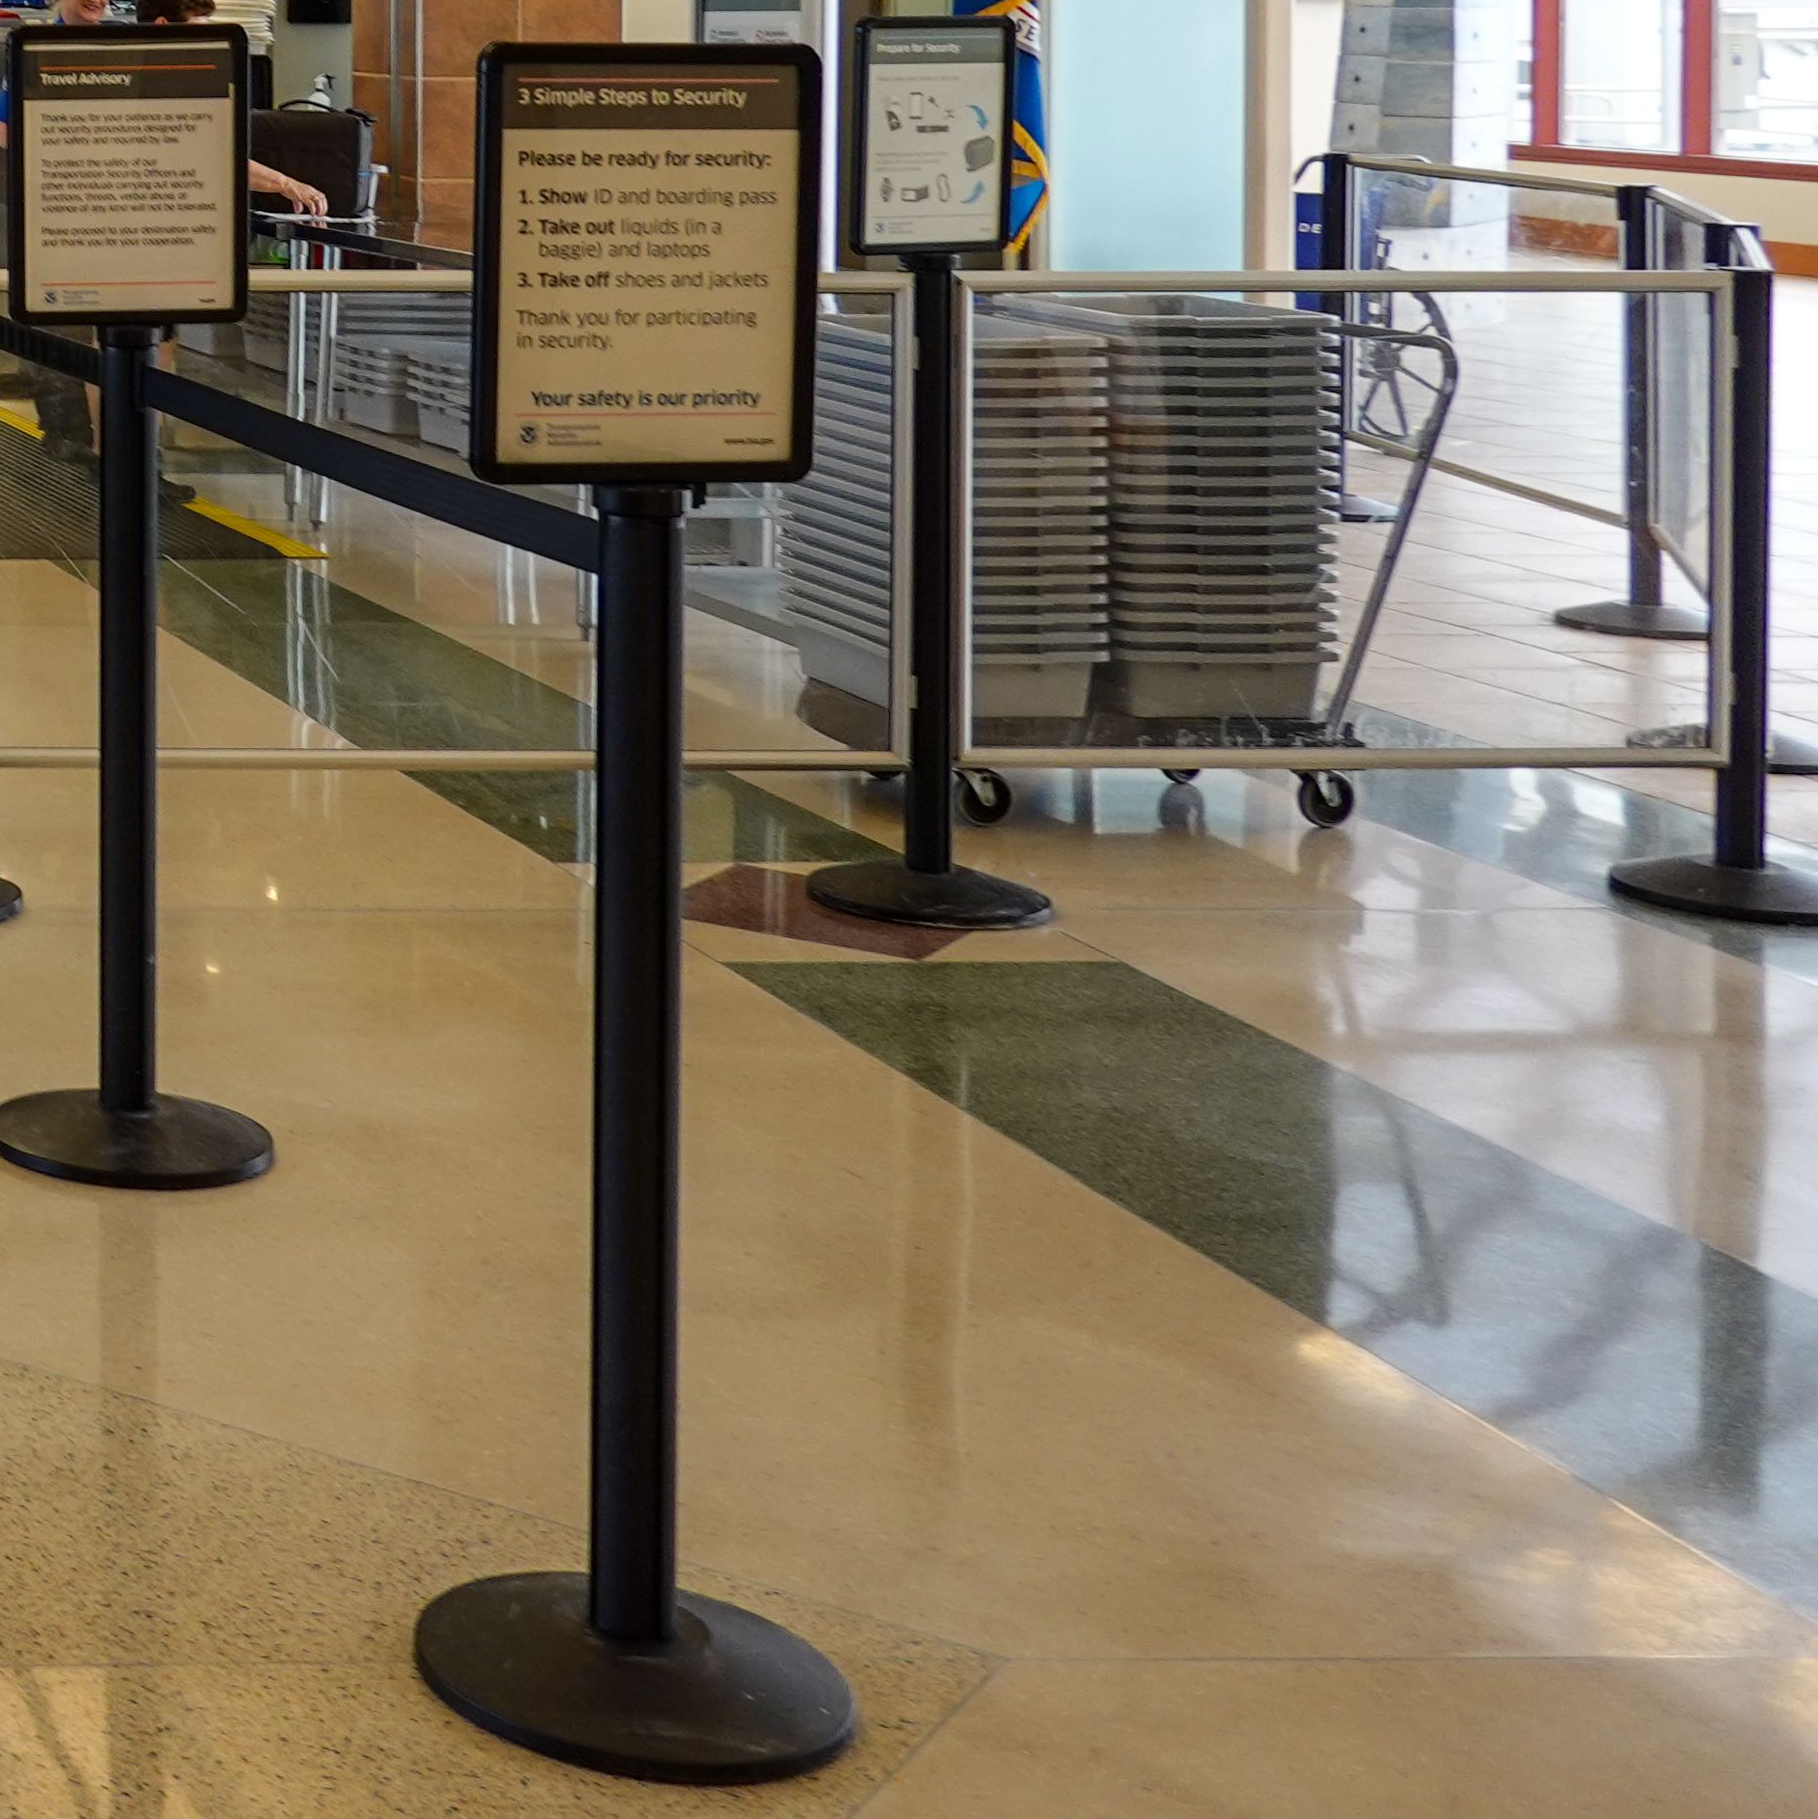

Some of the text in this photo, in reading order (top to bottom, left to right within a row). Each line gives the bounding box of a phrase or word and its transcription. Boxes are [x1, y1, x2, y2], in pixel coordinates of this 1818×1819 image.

[40, 73, 131, 86] Travel Advisory
[518, 88, 747, 109] 3 Simple Steps to Security
[517, 150, 772, 170] Please be ready for security:
[518, 189, 778, 209] 1. Show ID and boarding pass
[517, 218, 722, 238] 2. Take out liquids (in a
[538, 241, 711, 261] baggie) and laptops
[517, 271, 769, 291] 3. Take off shoes and jackets
[516, 308, 758, 330] Thank you for participating
[515, 332, 613, 352] in security.
[530, 389, 760, 410] Your safety is our priority
